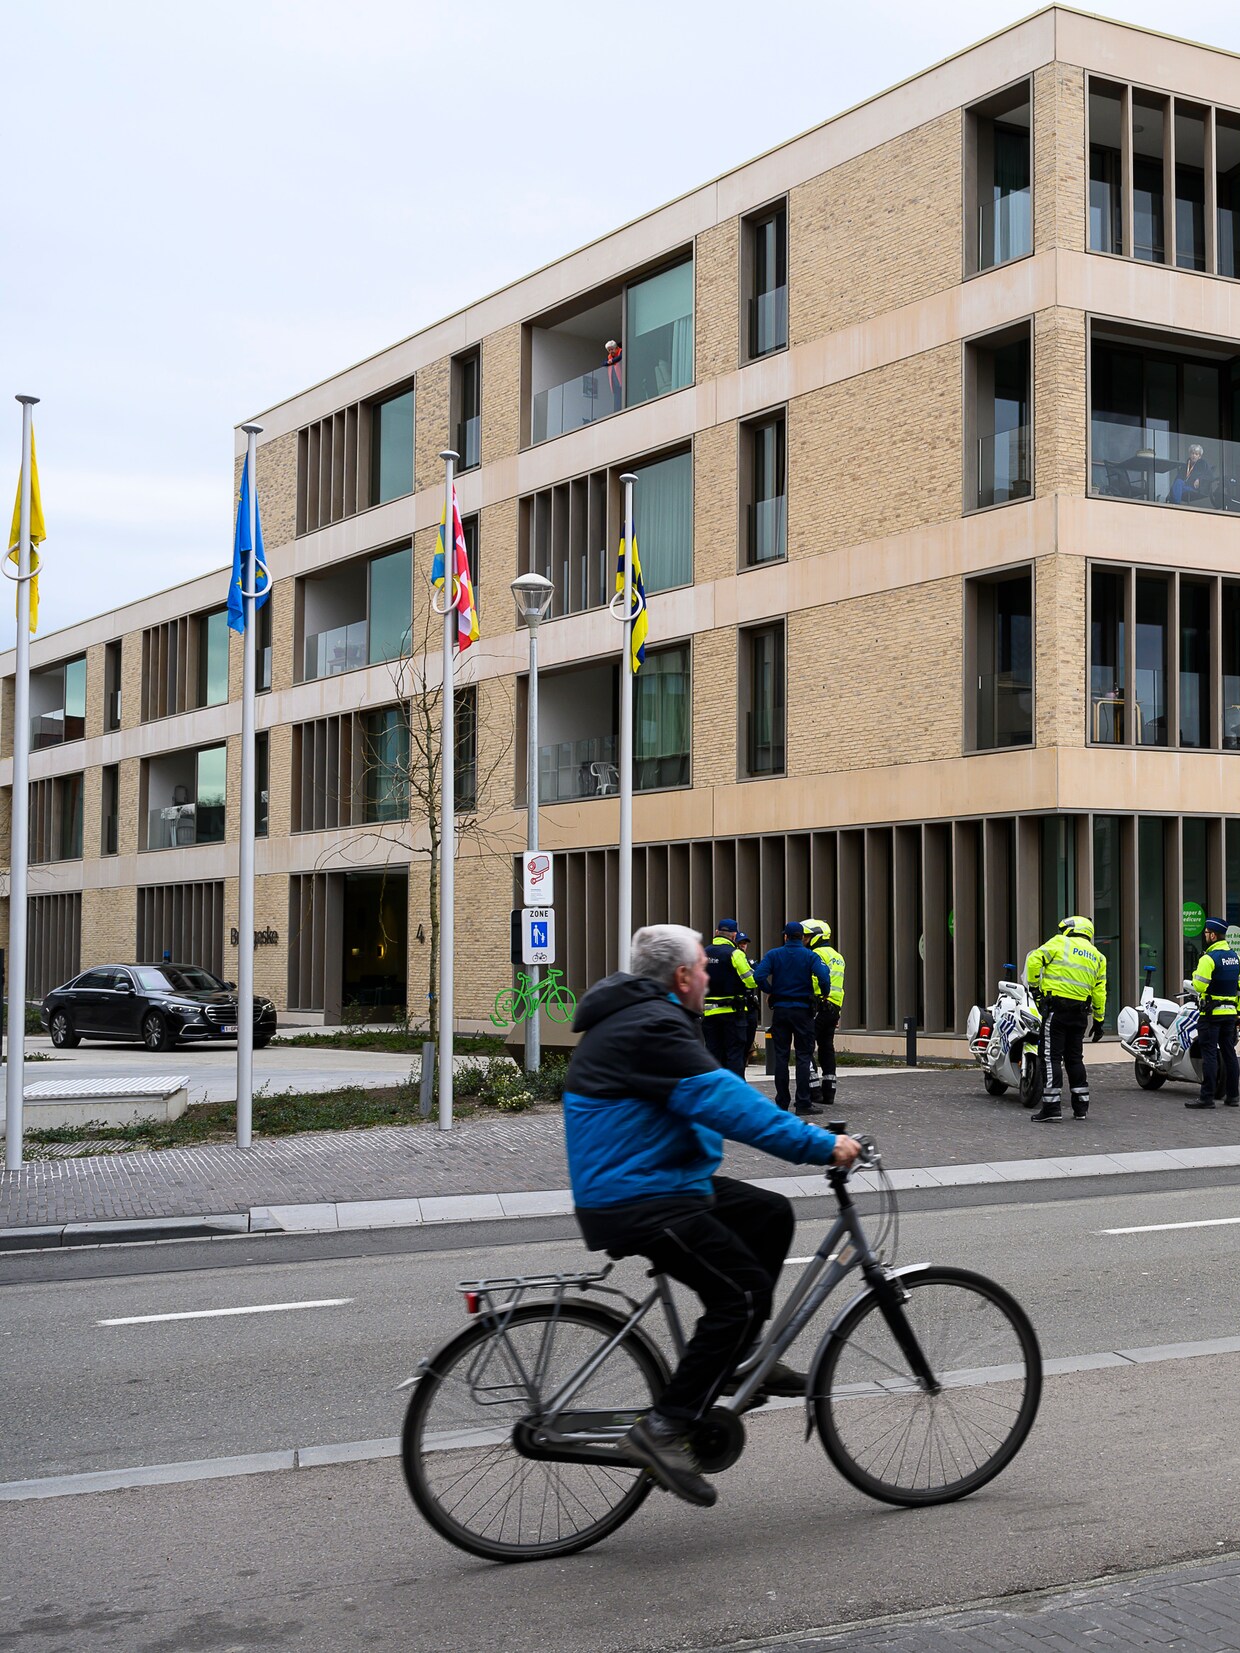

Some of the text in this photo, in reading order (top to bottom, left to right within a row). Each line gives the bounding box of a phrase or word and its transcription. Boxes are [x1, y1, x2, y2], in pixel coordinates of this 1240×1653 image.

[416, 924, 425, 944] 4
[1073, 948, 1097, 962] Politie
[1221, 957, 1239, 966] Politie
